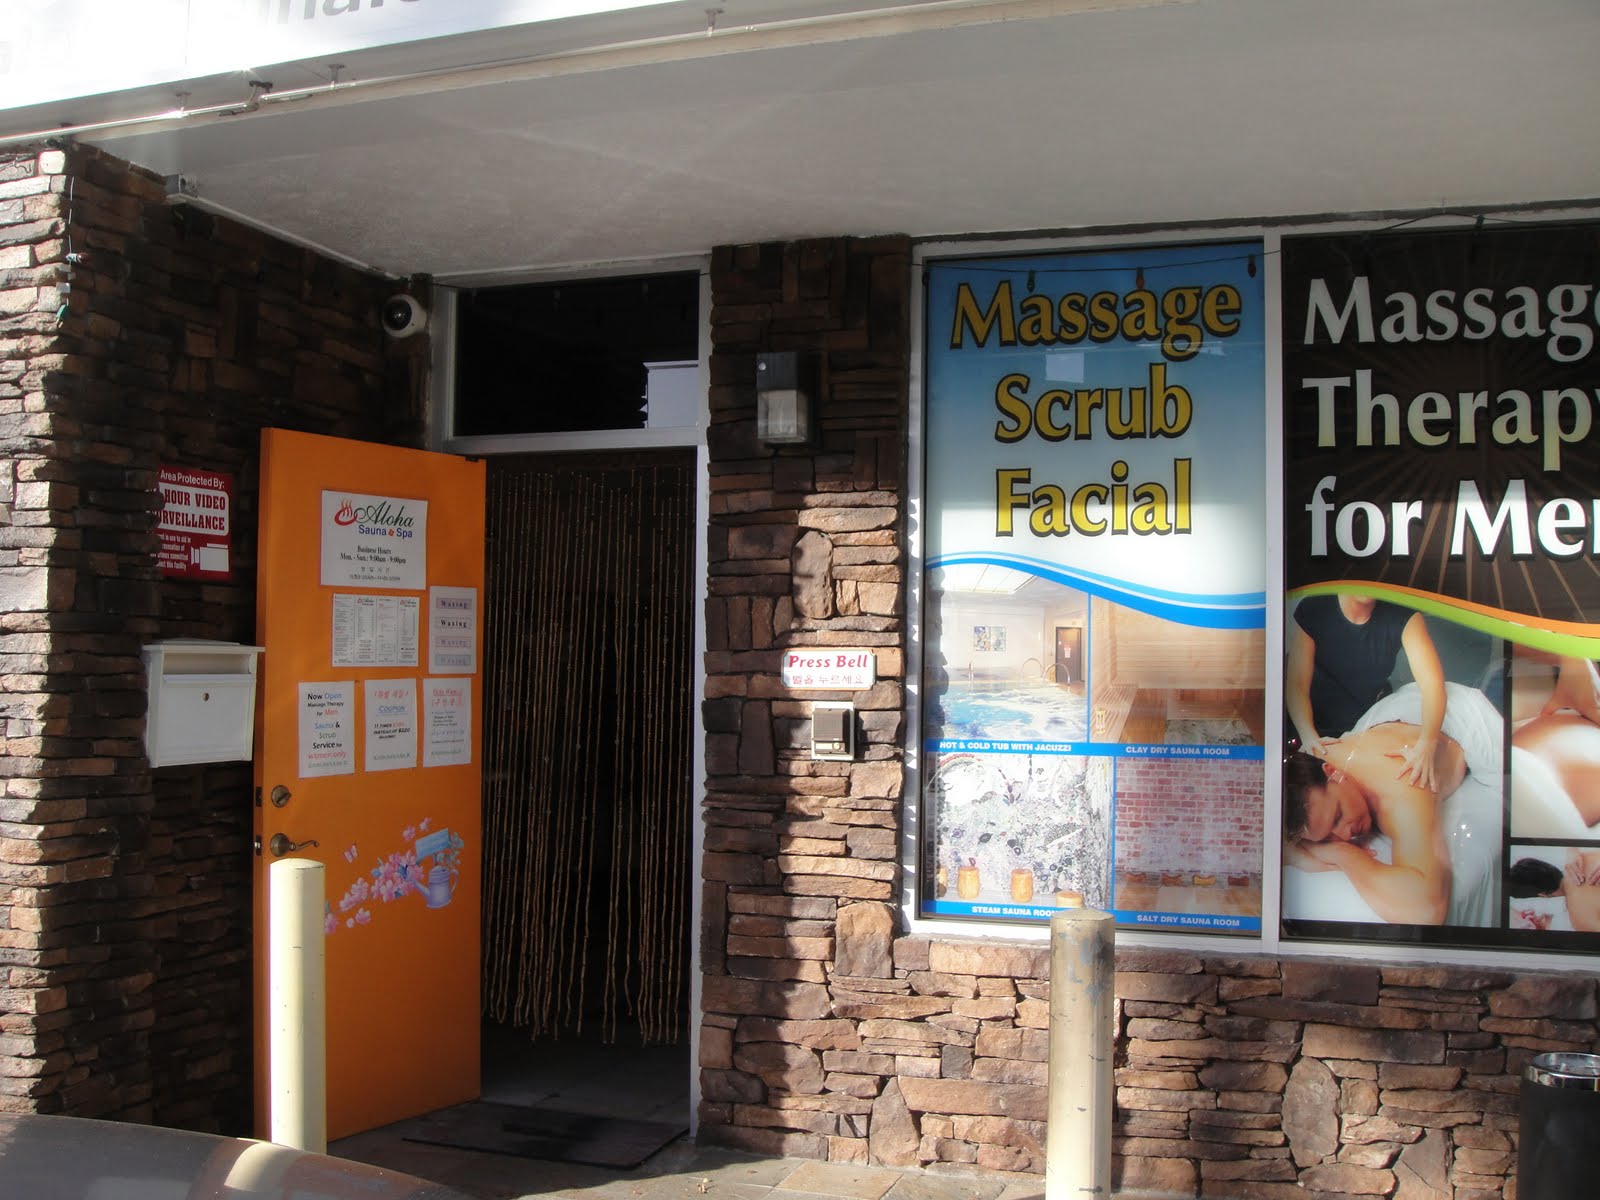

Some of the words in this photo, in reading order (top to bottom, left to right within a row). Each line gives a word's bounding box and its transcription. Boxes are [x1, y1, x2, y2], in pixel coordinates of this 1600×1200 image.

[950, 279, 1242, 362] Massage
[1303, 276, 1600, 363] Massag
[994, 362, 1193, 444] Scrub
[1302, 368, 1600, 472] Therap
[160, 469, 177, 482] Area
[177, 472, 213, 487] Protected
[164, 488, 191, 507] HOUR
[195, 493, 226, 511] VIDEO
[995, 457, 1193, 538] Facial
[354, 500, 415, 528] Aloha
[1305, 475, 1423, 558] for
[1450, 479, 1600, 559] Me
[358, 524, 387, 536] Sauna
[396, 527, 413, 540] Spa
[377, 547, 392, 555] Hours
[440, 619, 467, 628] Waxing
[788, 655, 831, 668] Press
[836, 654, 868, 668] Bell
[324, 692, 342, 700] Open
[324, 708, 339, 716] Men
[314, 722, 335, 730] Sauna
[319, 731, 337, 739] Scrub
[312, 741, 336, 750] Service
[940, 741, 957, 749] HOT
[967, 742, 990, 750] COLD
[991, 742, 1009, 750] TUB
[1011, 743, 1033, 751] WITH
[1034, 744, 1072, 752] JACUZZI
[1125, 746, 1148, 754] CLAY
[1170, 747, 1200, 755] SAUNA
[1202, 747, 1230, 755] ROOM
[332, 750, 347, 759] only
[972, 906, 1001, 914] STEAM
[1002, 907, 1032, 916] SAUNA
[1136, 914, 1158, 923] SALT
[1160, 915, 1178, 923] DRY
[1180, 916, 1211, 925] SAUNA
[1213, 918, 1240, 927] ROOM
